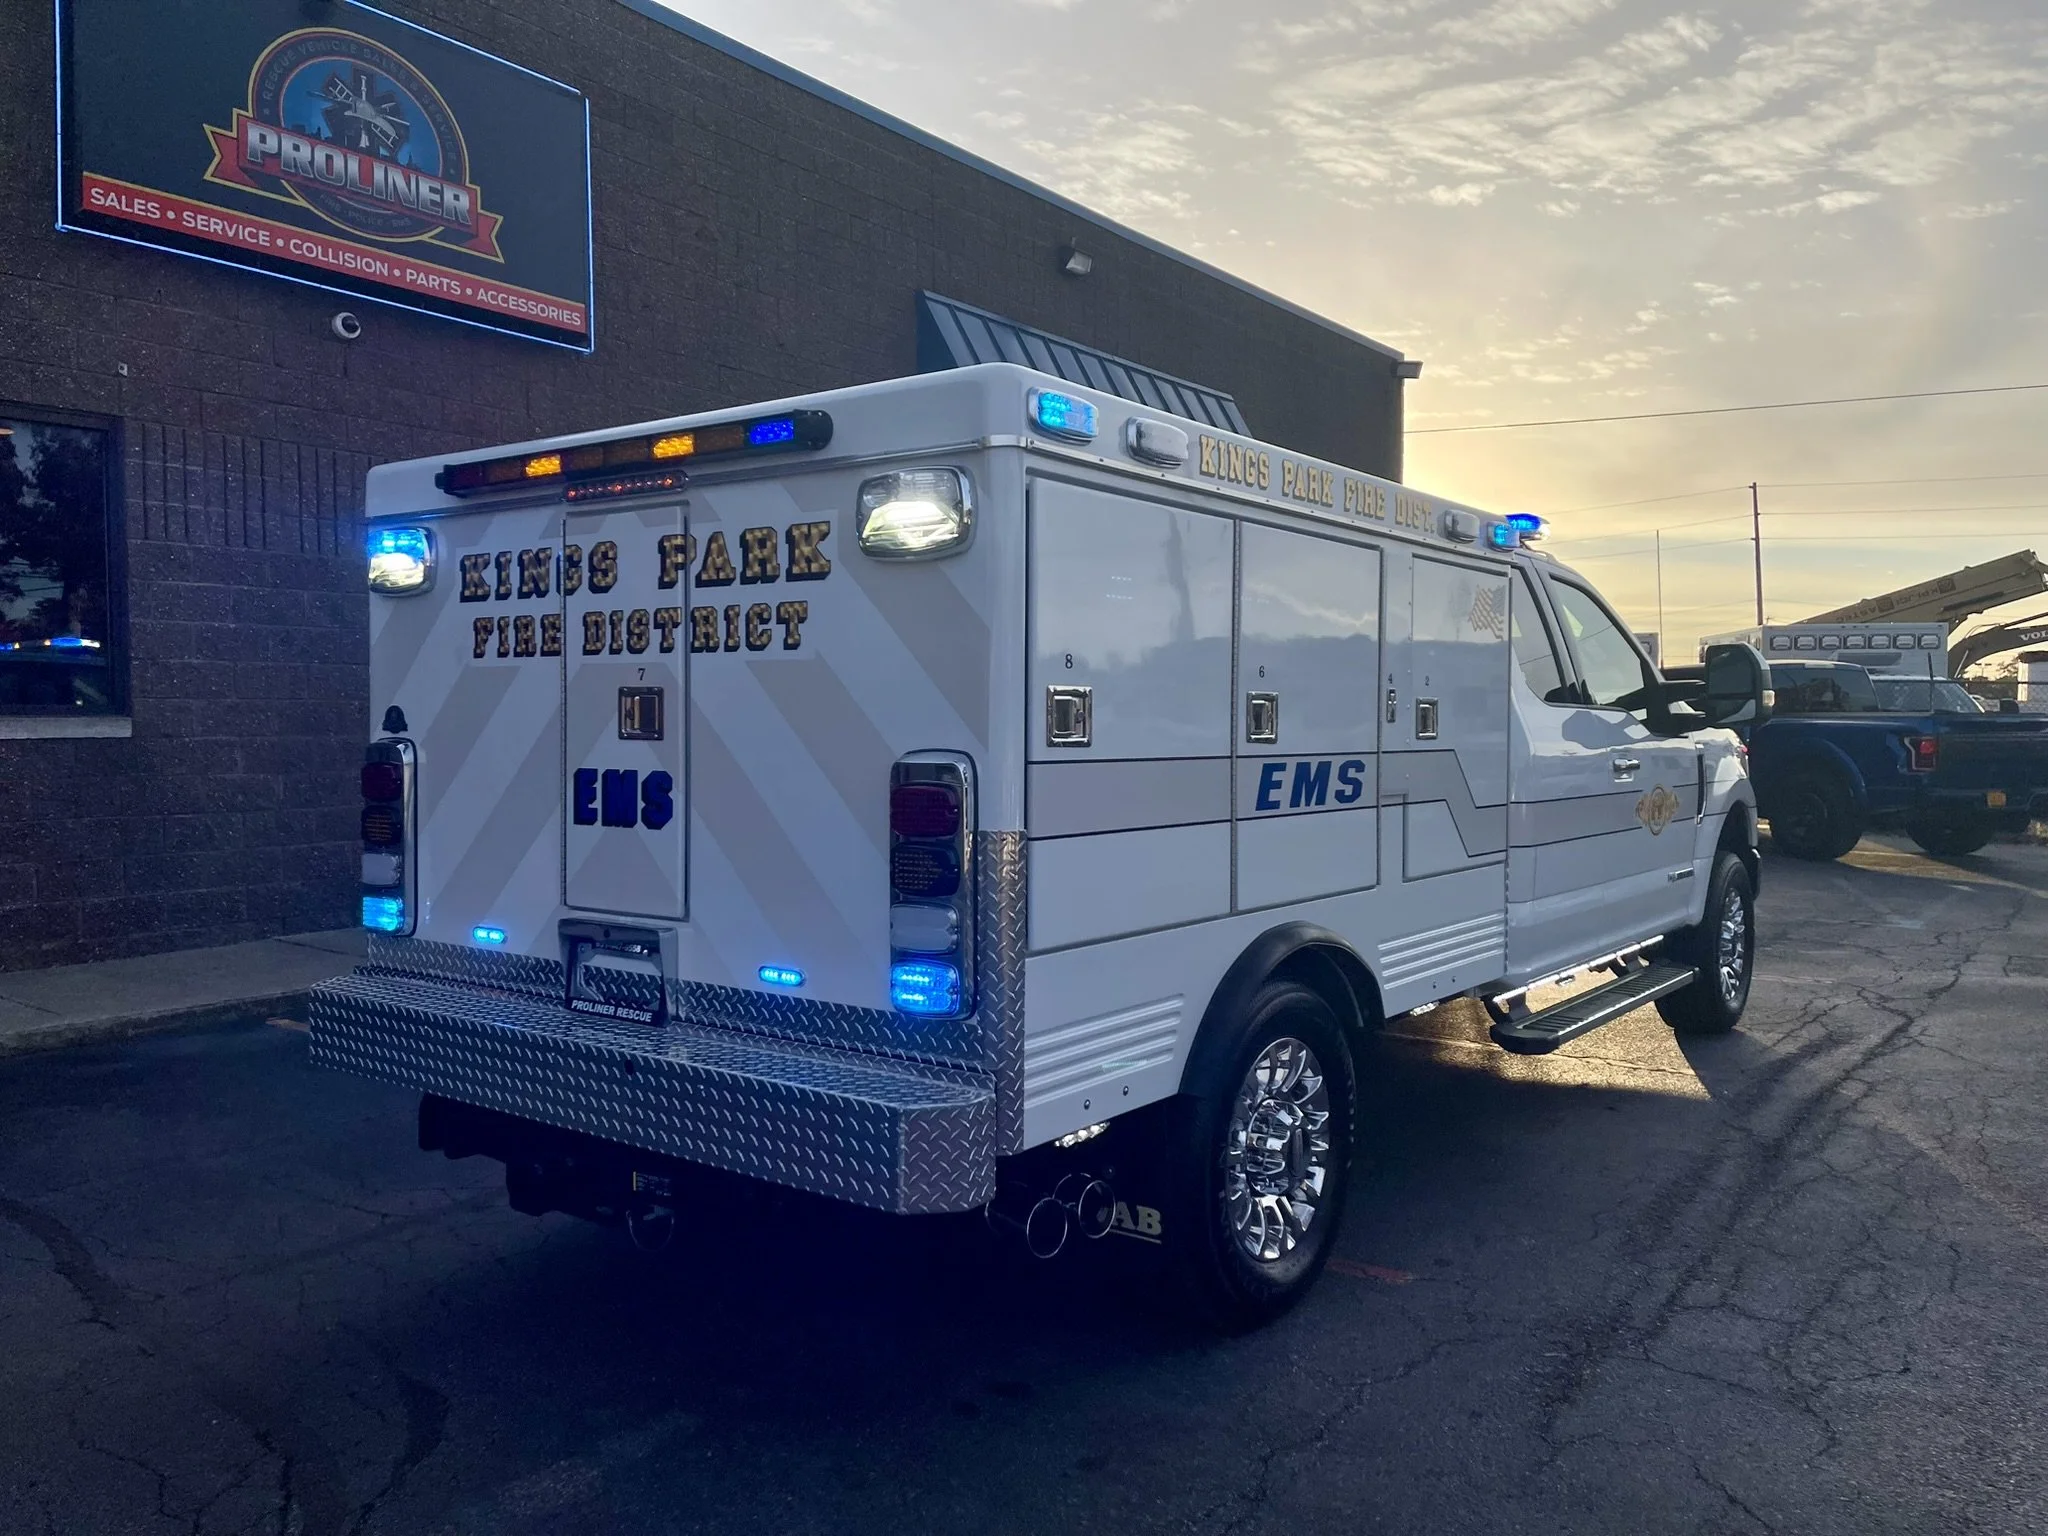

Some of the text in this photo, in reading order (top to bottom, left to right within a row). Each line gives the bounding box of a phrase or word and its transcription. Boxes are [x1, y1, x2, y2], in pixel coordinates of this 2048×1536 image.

[262, 50, 297, 100] RESCUE
[298, 40, 356, 55] VEHICLE
[247, 122, 472, 225] PROLINER
[90, 187, 582, 326] SALES SERVICE COLLISION PARTS ACCESSORIES
[1200, 434, 1435, 533] KINGS PARK FIRE DIST.
[460, 521, 832, 603] KINGS PARK
[473, 600, 808, 658] FIRE DISTRICT
[637, 667, 646, 681] 7
[1065, 654, 1073, 669] 8
[1258, 665, 1265, 678] 6
[1388, 673, 1393, 684] 4
[573, 768, 673, 830] EMS
[1255, 759, 1366, 811] EMS
[571, 1000, 653, 1022] PROLINER RESCUE
